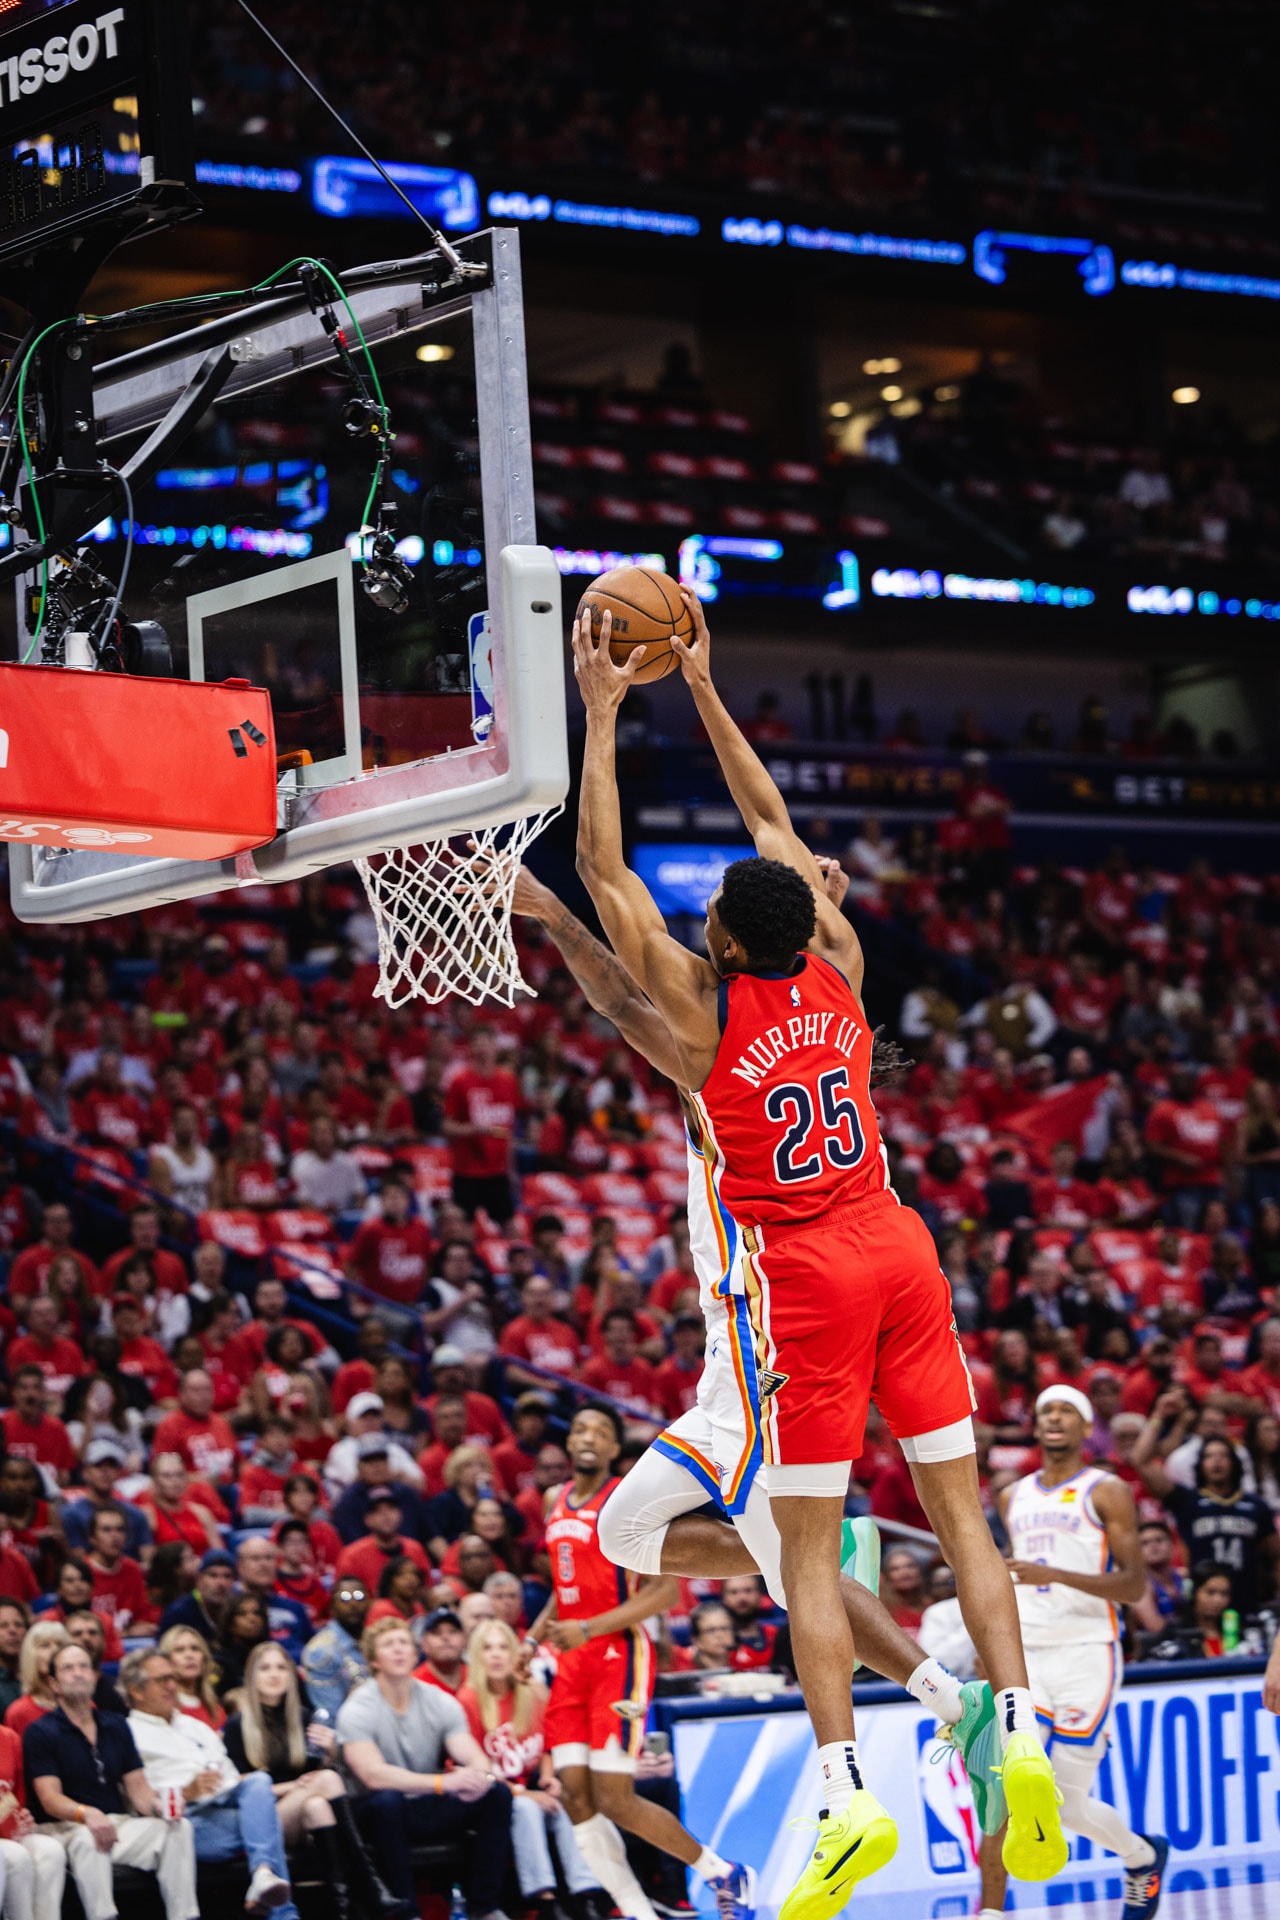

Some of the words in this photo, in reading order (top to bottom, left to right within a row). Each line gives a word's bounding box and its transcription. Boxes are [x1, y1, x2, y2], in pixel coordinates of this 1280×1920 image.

[731, 1012, 835, 1088] MURPHY
[834, 1016, 862, 1058] III
[765, 1066, 866, 1184] 25
